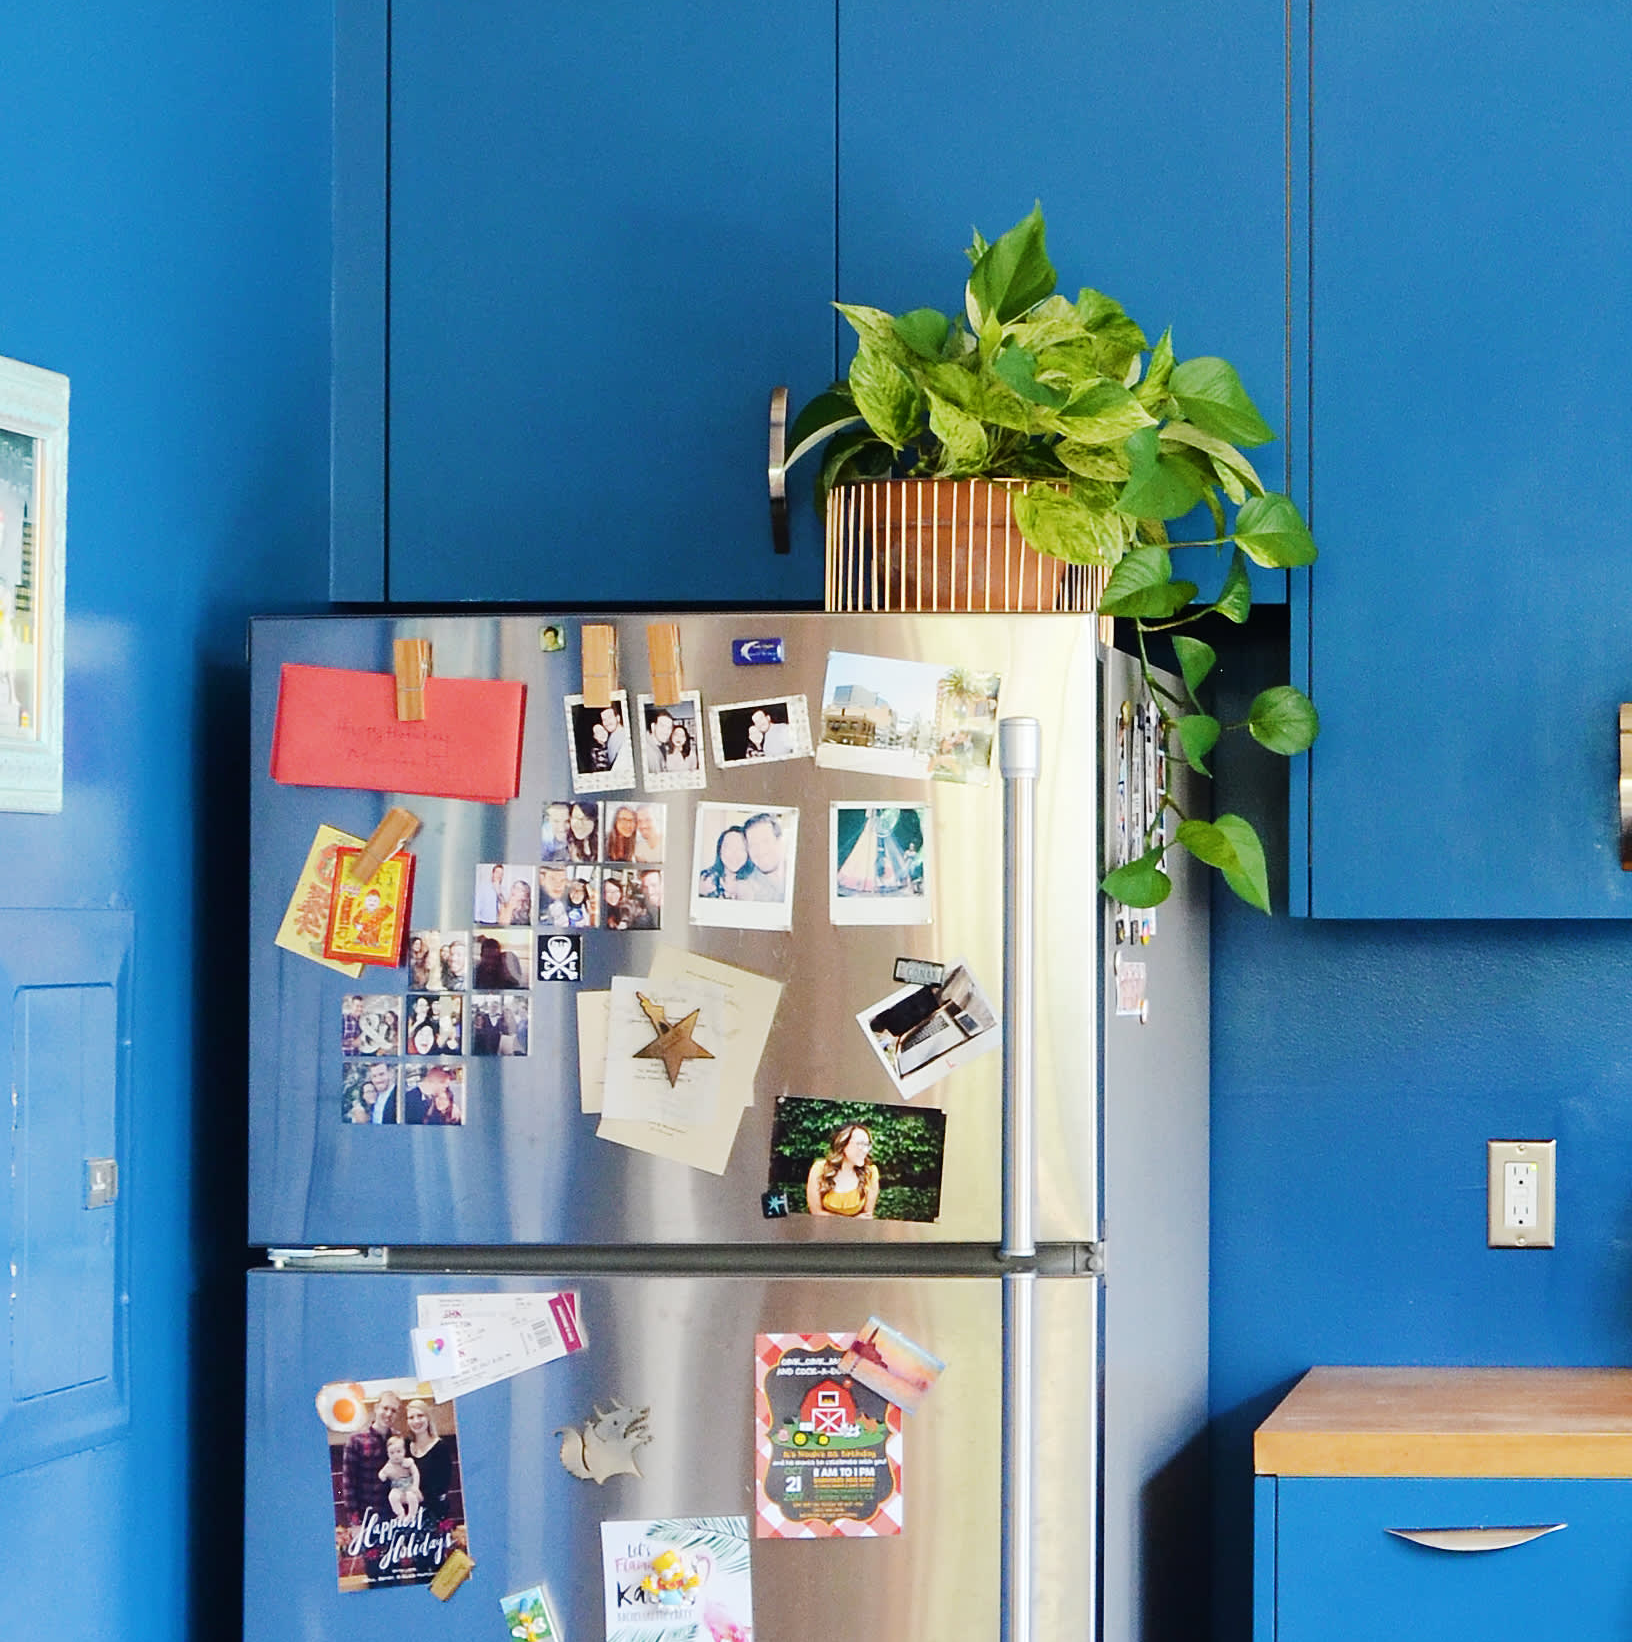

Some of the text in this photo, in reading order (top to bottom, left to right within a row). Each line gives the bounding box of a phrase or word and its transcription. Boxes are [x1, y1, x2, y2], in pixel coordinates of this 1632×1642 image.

[859, 1467, 876, 1477] PM
[785, 1475, 802, 1492] 21
[379, 1530, 457, 1569] Holidays
